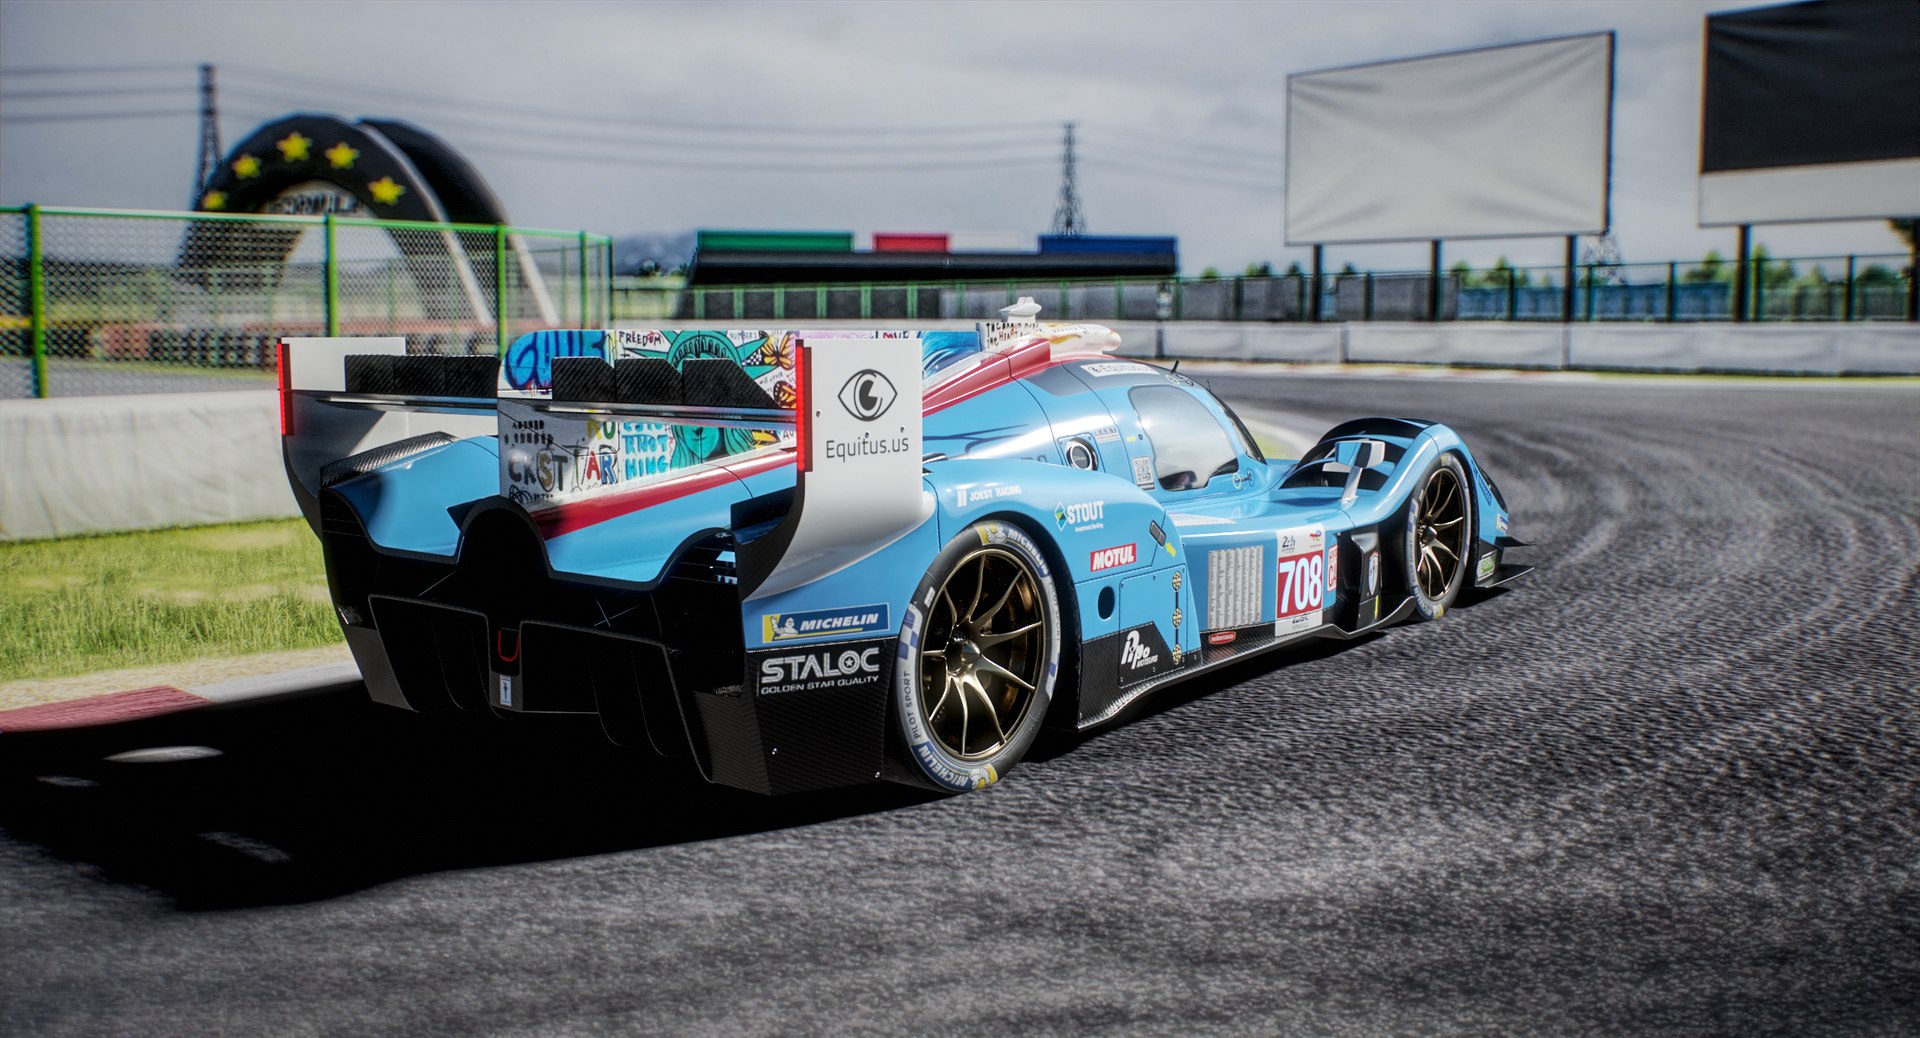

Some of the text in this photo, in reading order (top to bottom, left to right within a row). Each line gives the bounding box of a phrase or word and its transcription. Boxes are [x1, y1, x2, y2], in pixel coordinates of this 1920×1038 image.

[618, 331, 662, 347] FREEDOM
[826, 437, 909, 463] Equitus.us
[969, 485, 1022, 502] JOEST RACING
[1067, 501, 1104, 525] STOUT
[1007, 528, 1049, 576] MICHELIN
[1092, 545, 1134, 571] MOTUL
[1279, 554, 1322, 614] 708
[800, 613, 879, 631] MICHELIN
[1121, 630, 1151, 670] Pipo
[1137, 655, 1159, 668] MOTEURS
[761, 647, 880, 684] STALOC
[761, 675, 880, 695] GOLDEN STAR QUALITY
[903, 670, 921, 739] PILOT SPORT
[918, 744, 969, 787] MICHELIN
